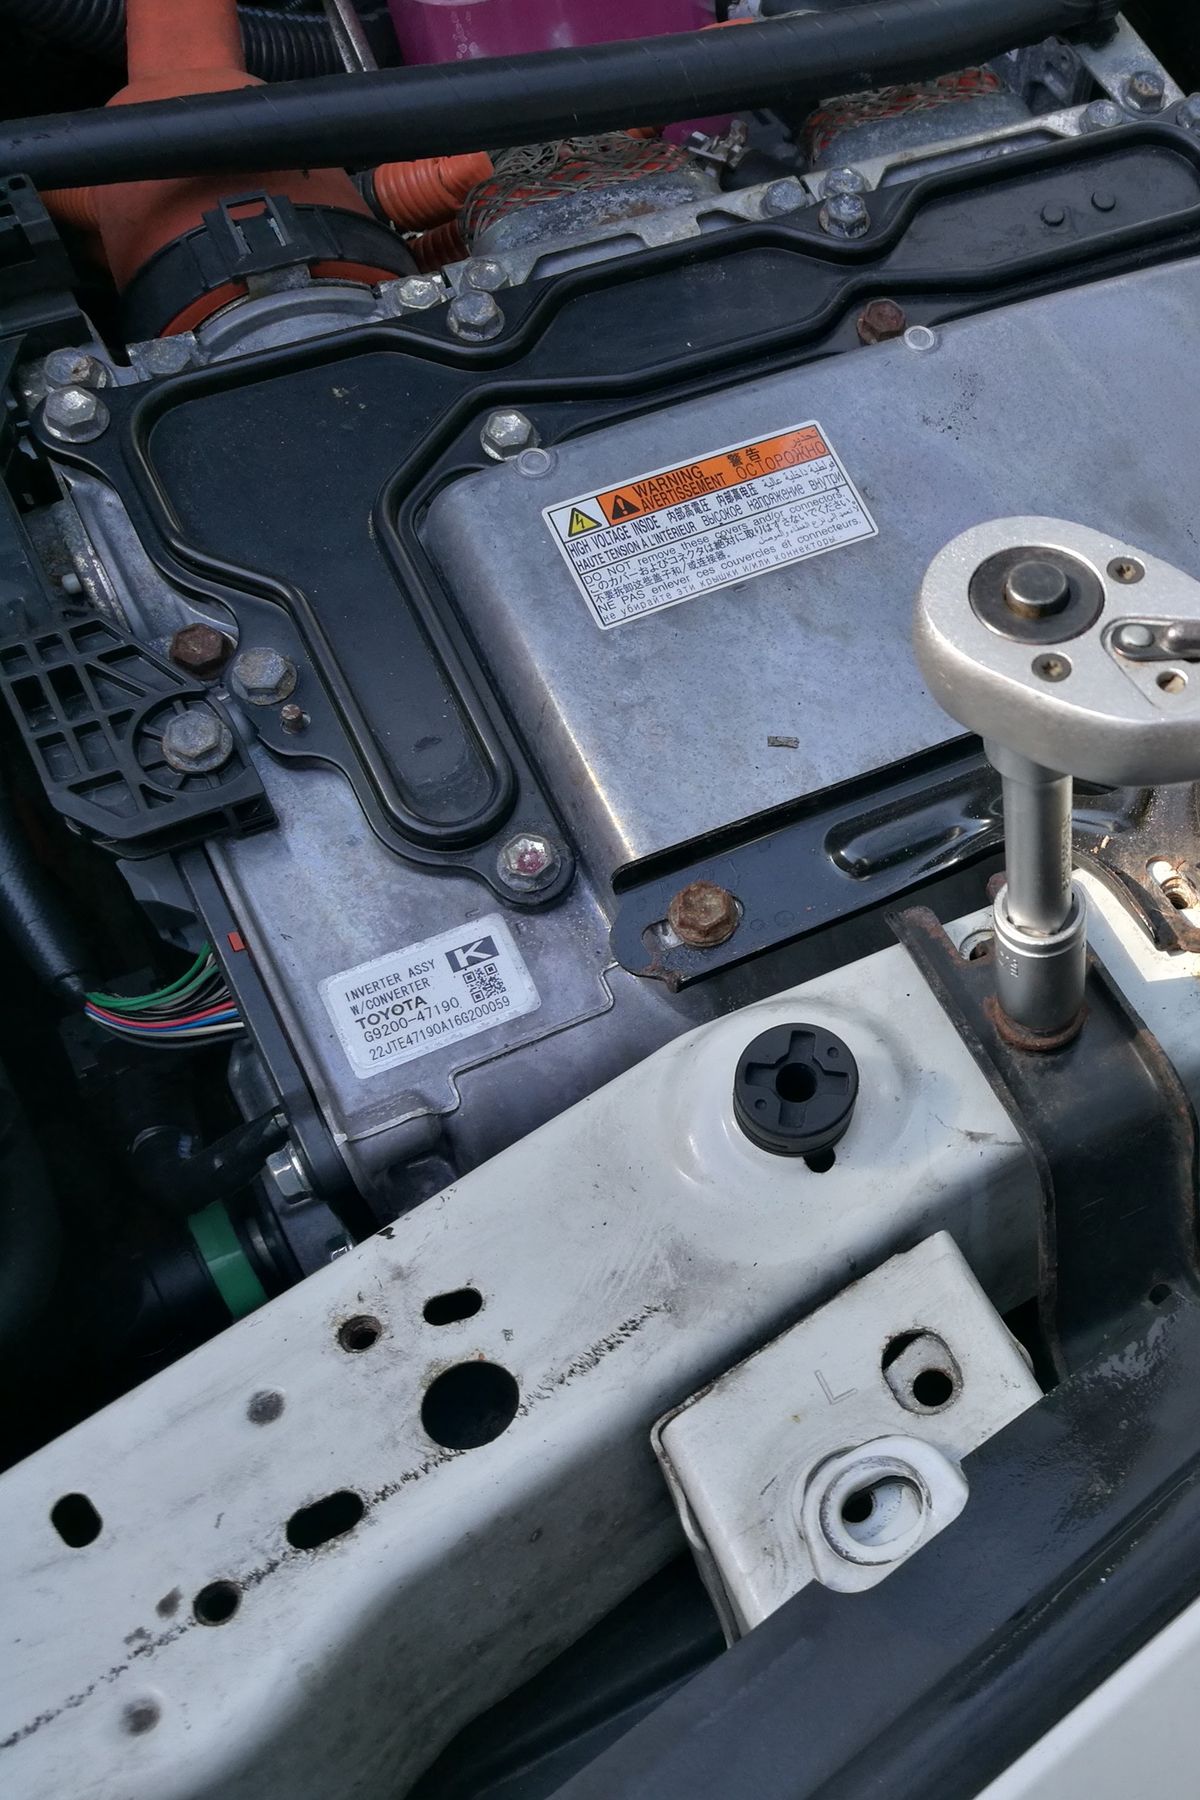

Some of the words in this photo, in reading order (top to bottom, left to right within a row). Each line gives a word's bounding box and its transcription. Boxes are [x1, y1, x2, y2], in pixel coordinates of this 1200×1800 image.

[735, 440, 826, 479] ОСТОРОЖНО
[632, 466, 703, 497] WARNING
[639, 473, 727, 511] AVERTISSEMENT
[567, 539, 591, 556] HIGH
[591, 525, 630, 548] VOLTAGE
[631, 516, 660, 534] INSIDE
[576, 553, 605, 570] HAUTE
[604, 541, 641, 560] TENSION
[638, 535, 649, 548] À
[646, 519, 697, 545] L'INTÉRIEUR
[584, 572, 602, 583] DO
[607, 561, 632, 575] NOT
[637, 547, 676, 564] remove
[680, 535, 709, 549] these
[714, 523, 747, 538] covers
[752, 509, 784, 525] and/or
[598, 601, 616, 612] NE
[621, 590, 645, 603] PAS
[650, 575, 690, 593] enlever
[696, 567, 715, 577] ces
[719, 545, 776, 569] couvercles
[780, 539, 791, 548] et
[603, 612, 616, 621] не
[676, 584, 695, 595] эти
[345, 973, 401, 1001] INVERTER
[407, 959, 436, 977] ASSY
[350, 977, 430, 1015] W/CONVERTER
[355, 995, 427, 1029] TOYOTA
[363, 996, 460, 1042] G9200-47190
[368, 996, 511, 1059] 22JTE47190A16G200059
